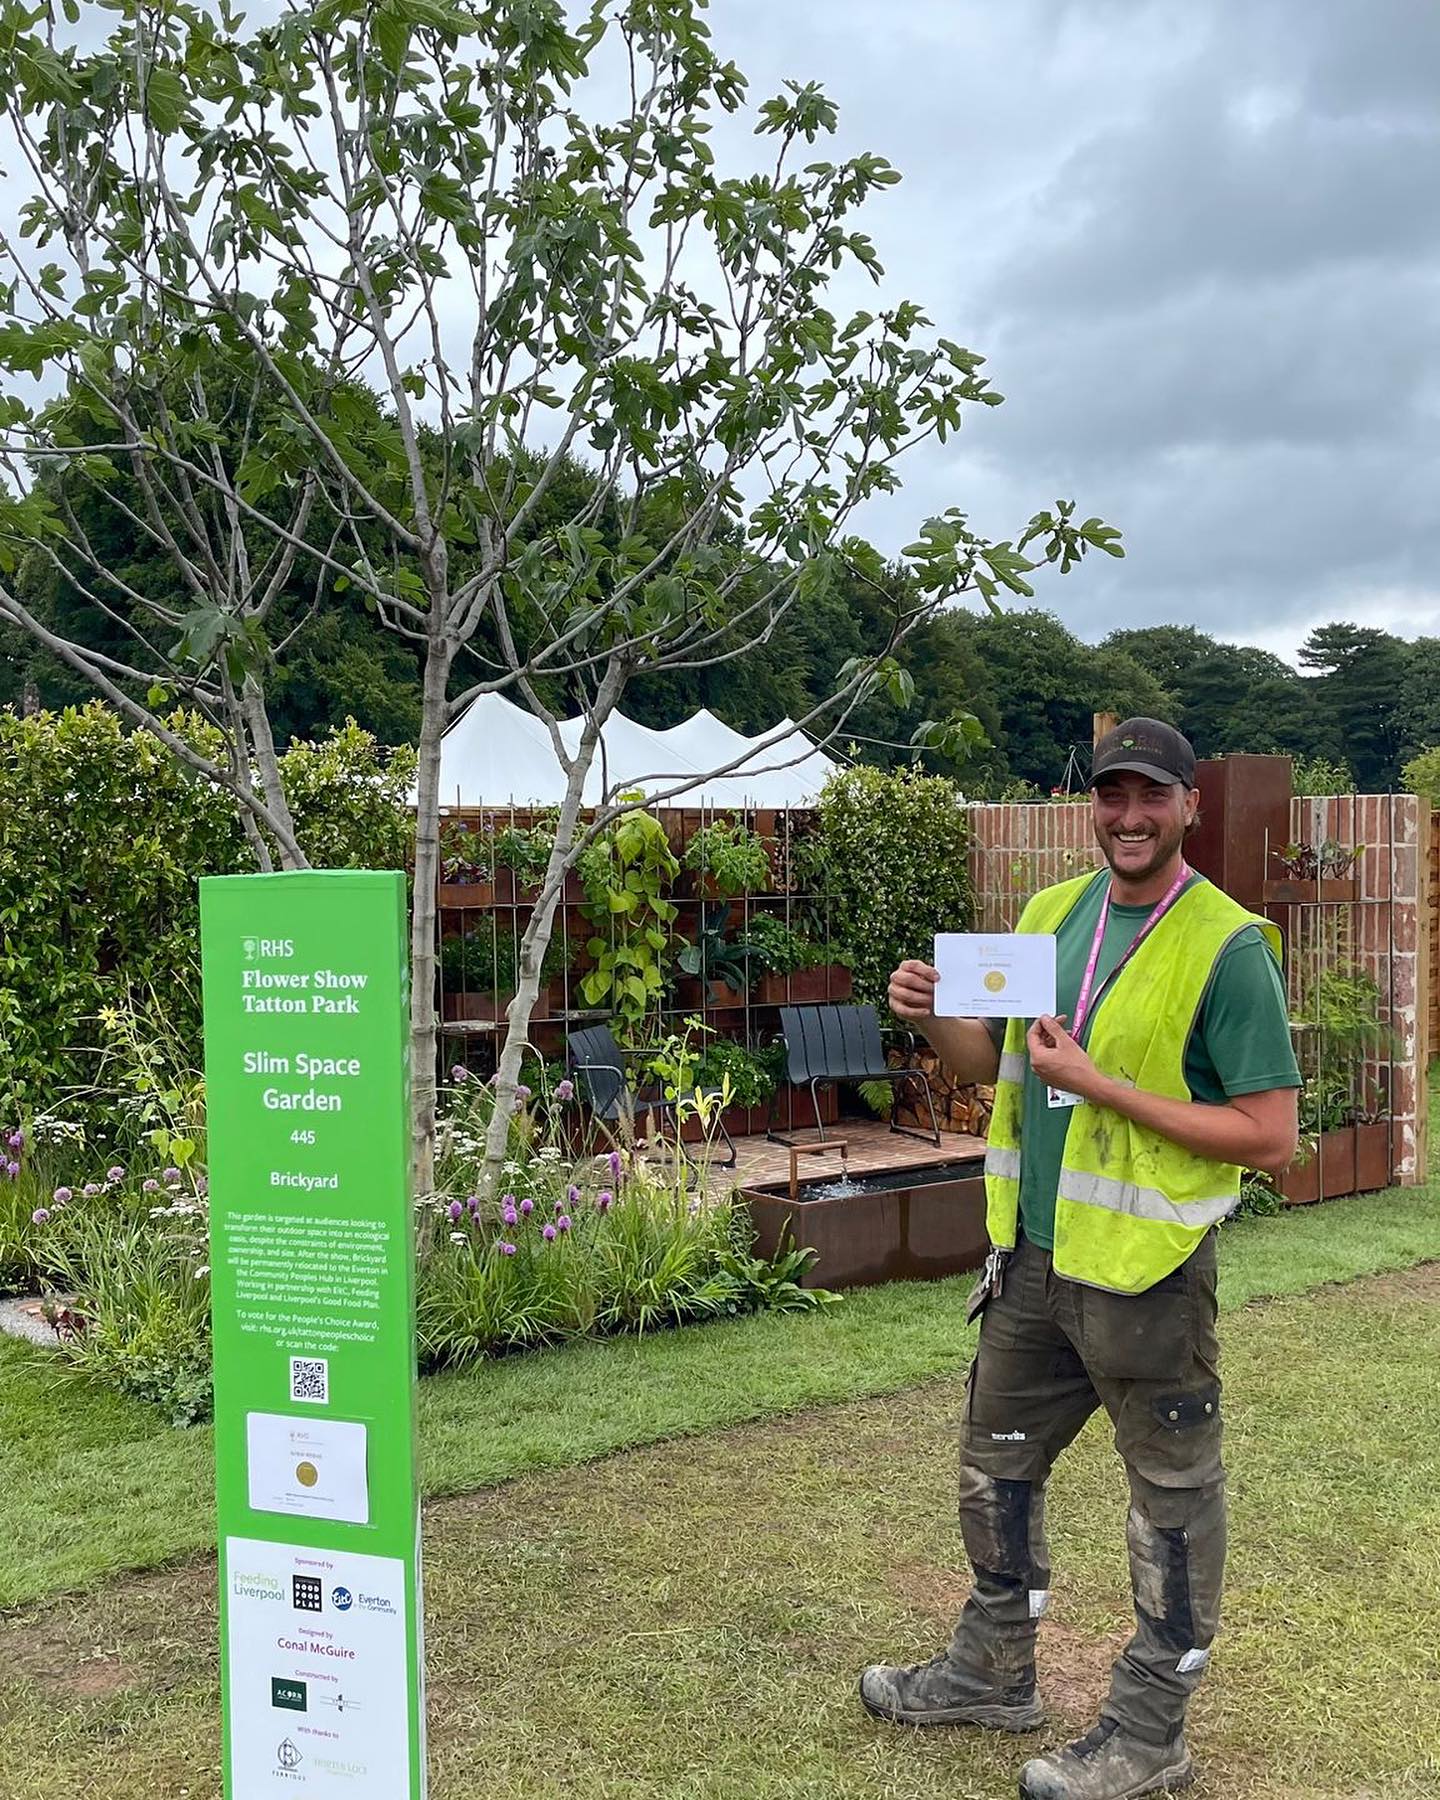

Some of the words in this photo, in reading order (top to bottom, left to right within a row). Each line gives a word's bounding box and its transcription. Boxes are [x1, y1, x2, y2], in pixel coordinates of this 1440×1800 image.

[261, 939, 294, 957] RHS
[242, 970, 309, 988] Flower
[314, 970, 368, 989] Show
[242, 995, 307, 1013] Tatton
[312, 995, 360, 1013] Park
[243, 1052, 289, 1073] Slim
[295, 1054, 360, 1080] Space
[263, 1088, 342, 1111] Garden
[290, 1130, 315, 1145] 445
[270, 1171, 338, 1191] Brickyard
[275, 1216, 304, 1225] targeted
[315, 1217, 349, 1226] audiences
[350, 1219, 376, 1230] looking
[277, 1227, 305, 1235] outdoor
[307, 1229, 327, 1237] space
[354, 1232, 389, 1242] ecological
[289, 1239, 327, 1248] constraints
[329, 1240, 336, 1248] of
[298, 1249, 315, 1258] After
[317, 1251, 329, 1259] the
[353, 1253, 387, 1264] Brickyard
[250, 1260, 293, 1270] permanently
[295, 1261, 327, 1271] relocated
[338, 1264, 350, 1272] the
[352, 1265, 379, 1274] Everton
[250, 1270, 289, 1281] Community
[237, 1280, 266, 1290] Working
[267, 1281, 274, 1289] in
[275, 1283, 315, 1294] partnership
[352, 1288, 379, 1299] Feeding
[236, 1291, 268, 1300] Liverpool
[284, 1294, 320, 1304] Liverpool's
[322, 1297, 341, 1305] Good
[343, 1298, 361, 1307] Food
[236, 1310, 247, 1318] To
[248, 1312, 264, 1320] vote
[265, 1312, 277, 1320] for
[278, 1313, 291, 1321] the
[292, 1314, 323, 1325] People's
[325, 1317, 351, 1327] Choice
[352, 1319, 379, 1330] Award,
[286, 1340, 303, 1348] scan
[304, 1341, 317, 1350] the
[233, 1571, 278, 1590] Feeding
[234, 1583, 285, 1601] Liverpool
[358, 1594, 391, 1607] Everton
[295, 1599, 320, 1609] PLAN
[277, 1637, 307, 1651] Conal
[310, 1642, 355, 1660] McGuire
